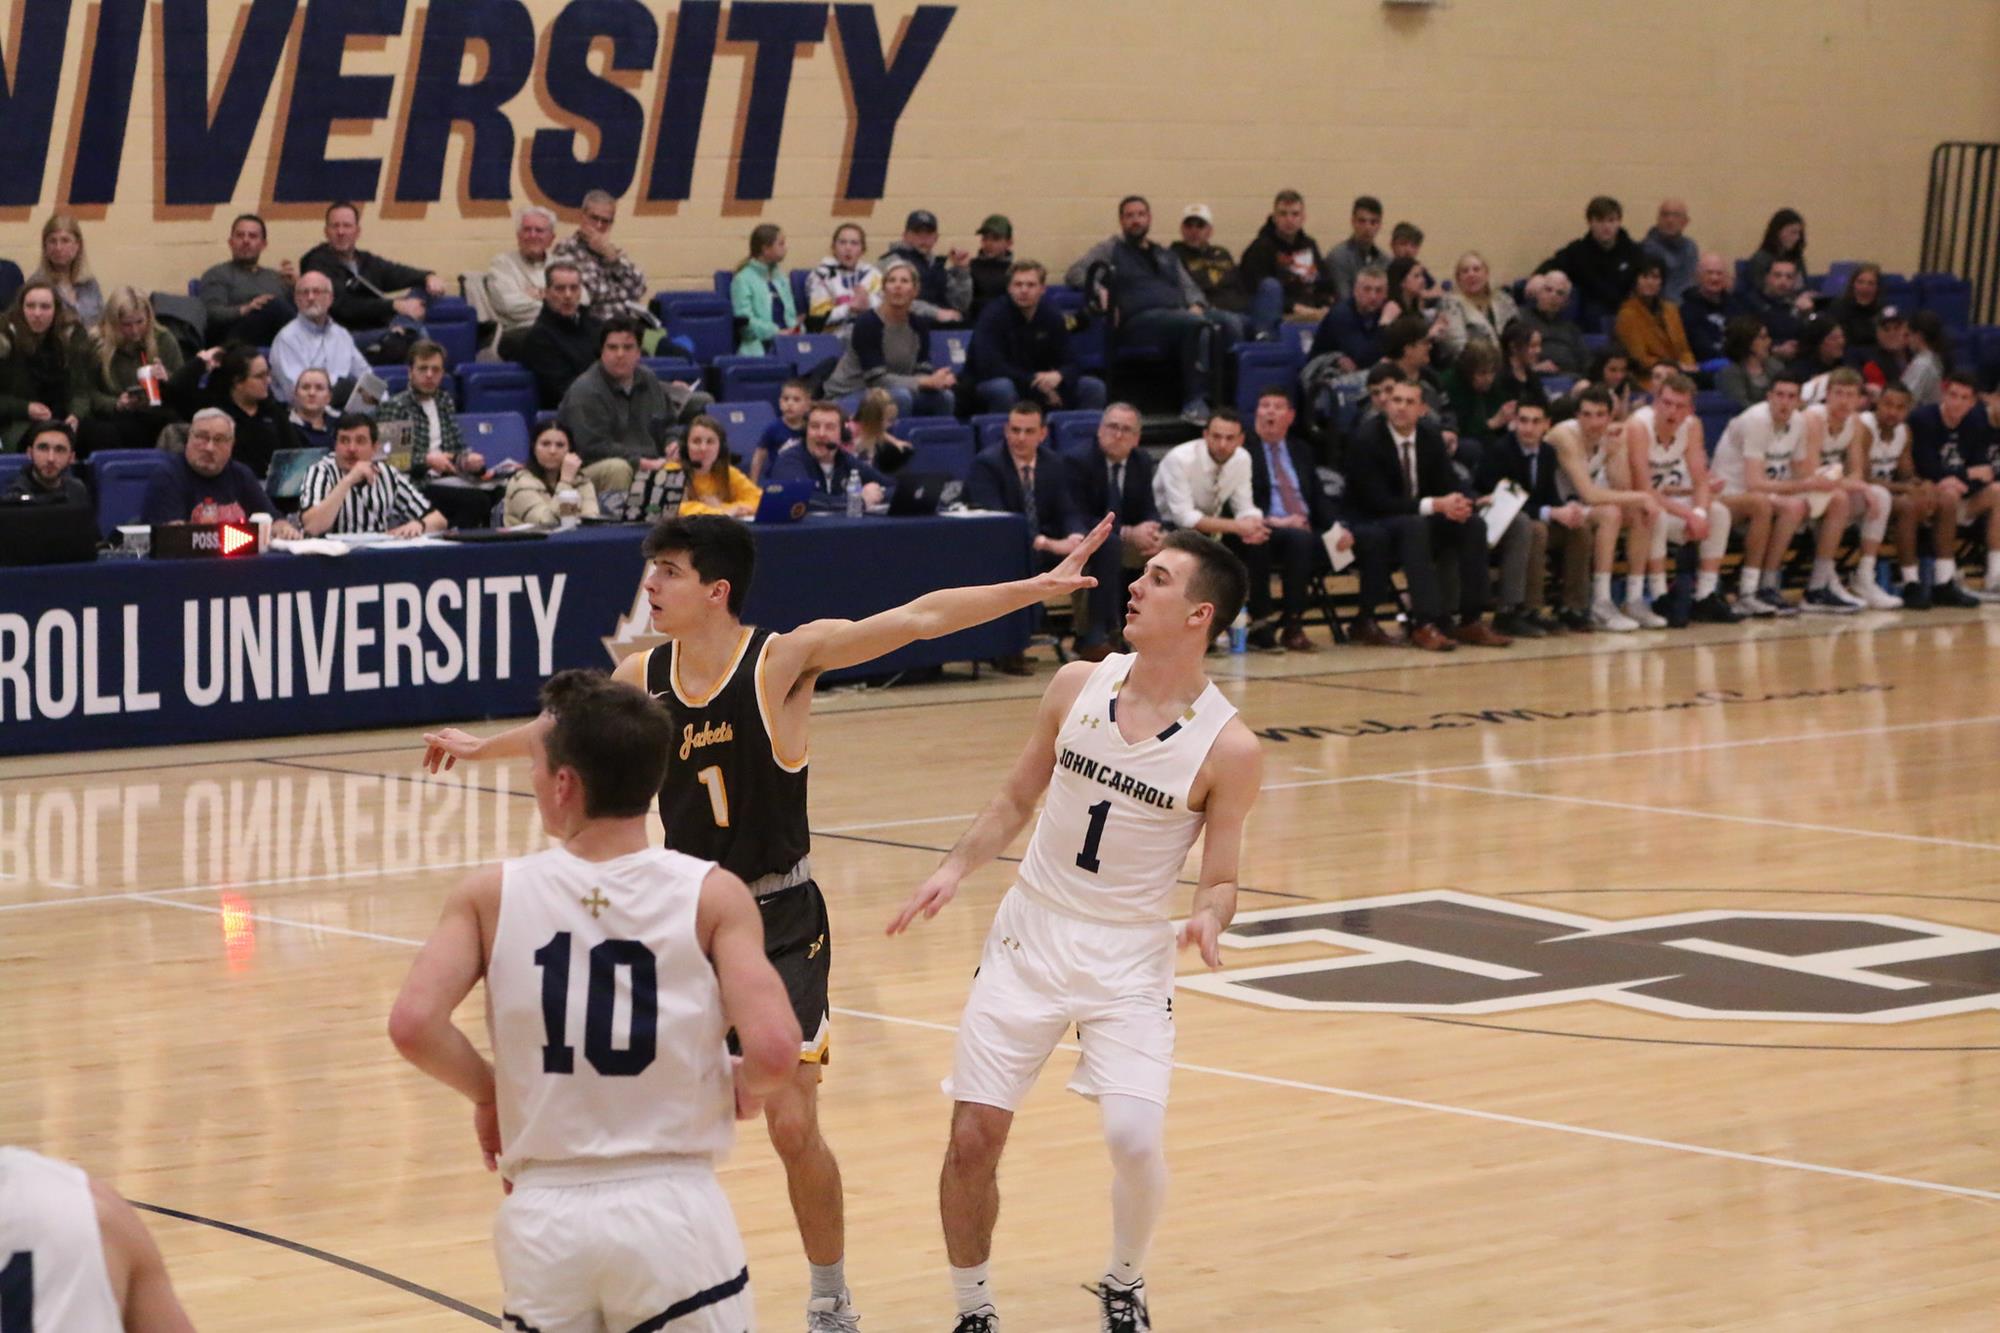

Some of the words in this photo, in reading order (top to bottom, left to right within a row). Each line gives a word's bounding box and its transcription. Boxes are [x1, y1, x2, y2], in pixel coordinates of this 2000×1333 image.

[183, 573, 567, 706] UNIVERSITY
[697, 765, 730, 828] 1
[1059, 747, 1099, 780] JOHN
[1096, 765, 1175, 810] CARROLL
[1075, 799, 1112, 874] 1
[534, 930, 659, 1077] 10
